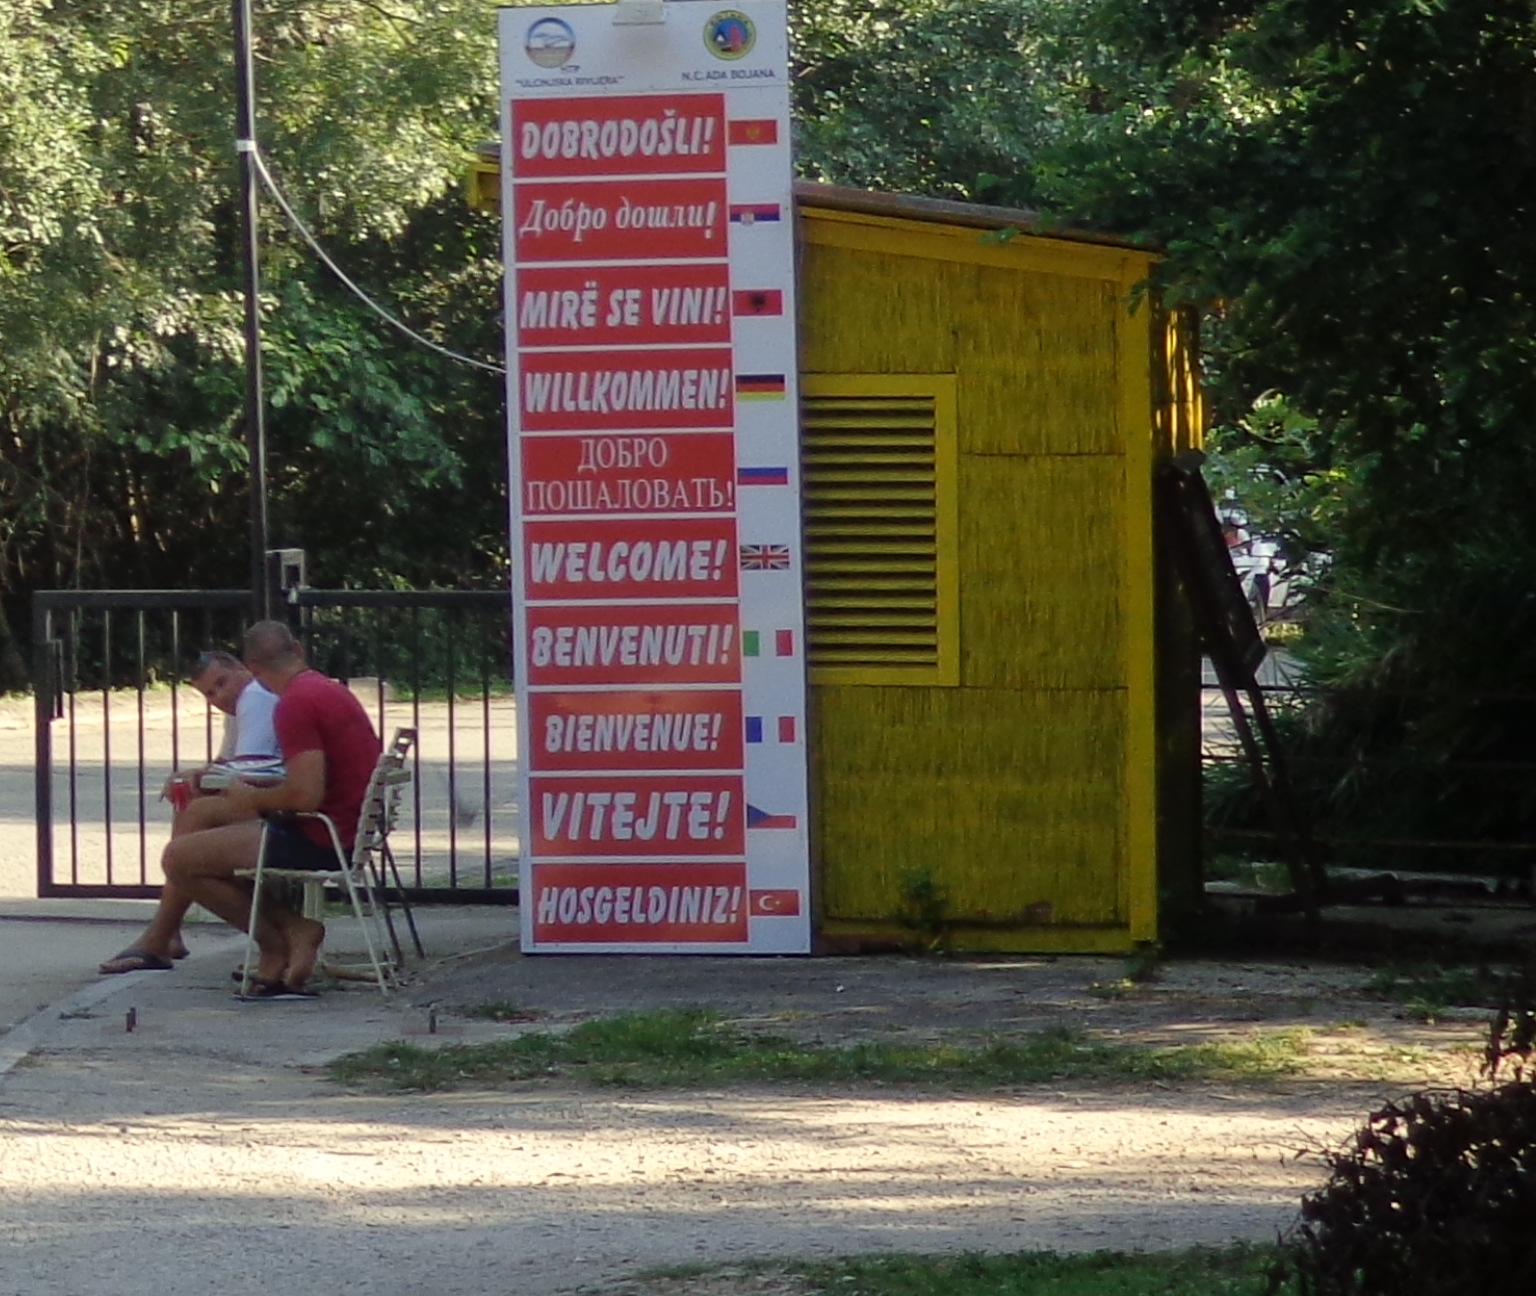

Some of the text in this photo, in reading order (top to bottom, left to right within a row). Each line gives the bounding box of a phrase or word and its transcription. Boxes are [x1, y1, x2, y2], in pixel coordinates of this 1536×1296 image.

[730, 68, 775, 79] BOJANA
[521, 109, 716, 160] DOBRODOŠLI!
[519, 196, 717, 242] Добро дошли!
[520, 281, 727, 329] MIRË SE VINI!
[525, 368, 730, 414] WILLKOMMEN!
[578, 437, 667, 473] ДОБРО
[528, 478, 733, 511] ПОШАЛОВАТЬ!
[530, 539, 727, 583] WELCOME!
[532, 624, 734, 666] BENVENUTI!
[545, 713, 722, 752] BIENVENUE!
[542, 791, 730, 841] VITEJTE!
[538, 886, 741, 924] HOSGELDINIZ!
